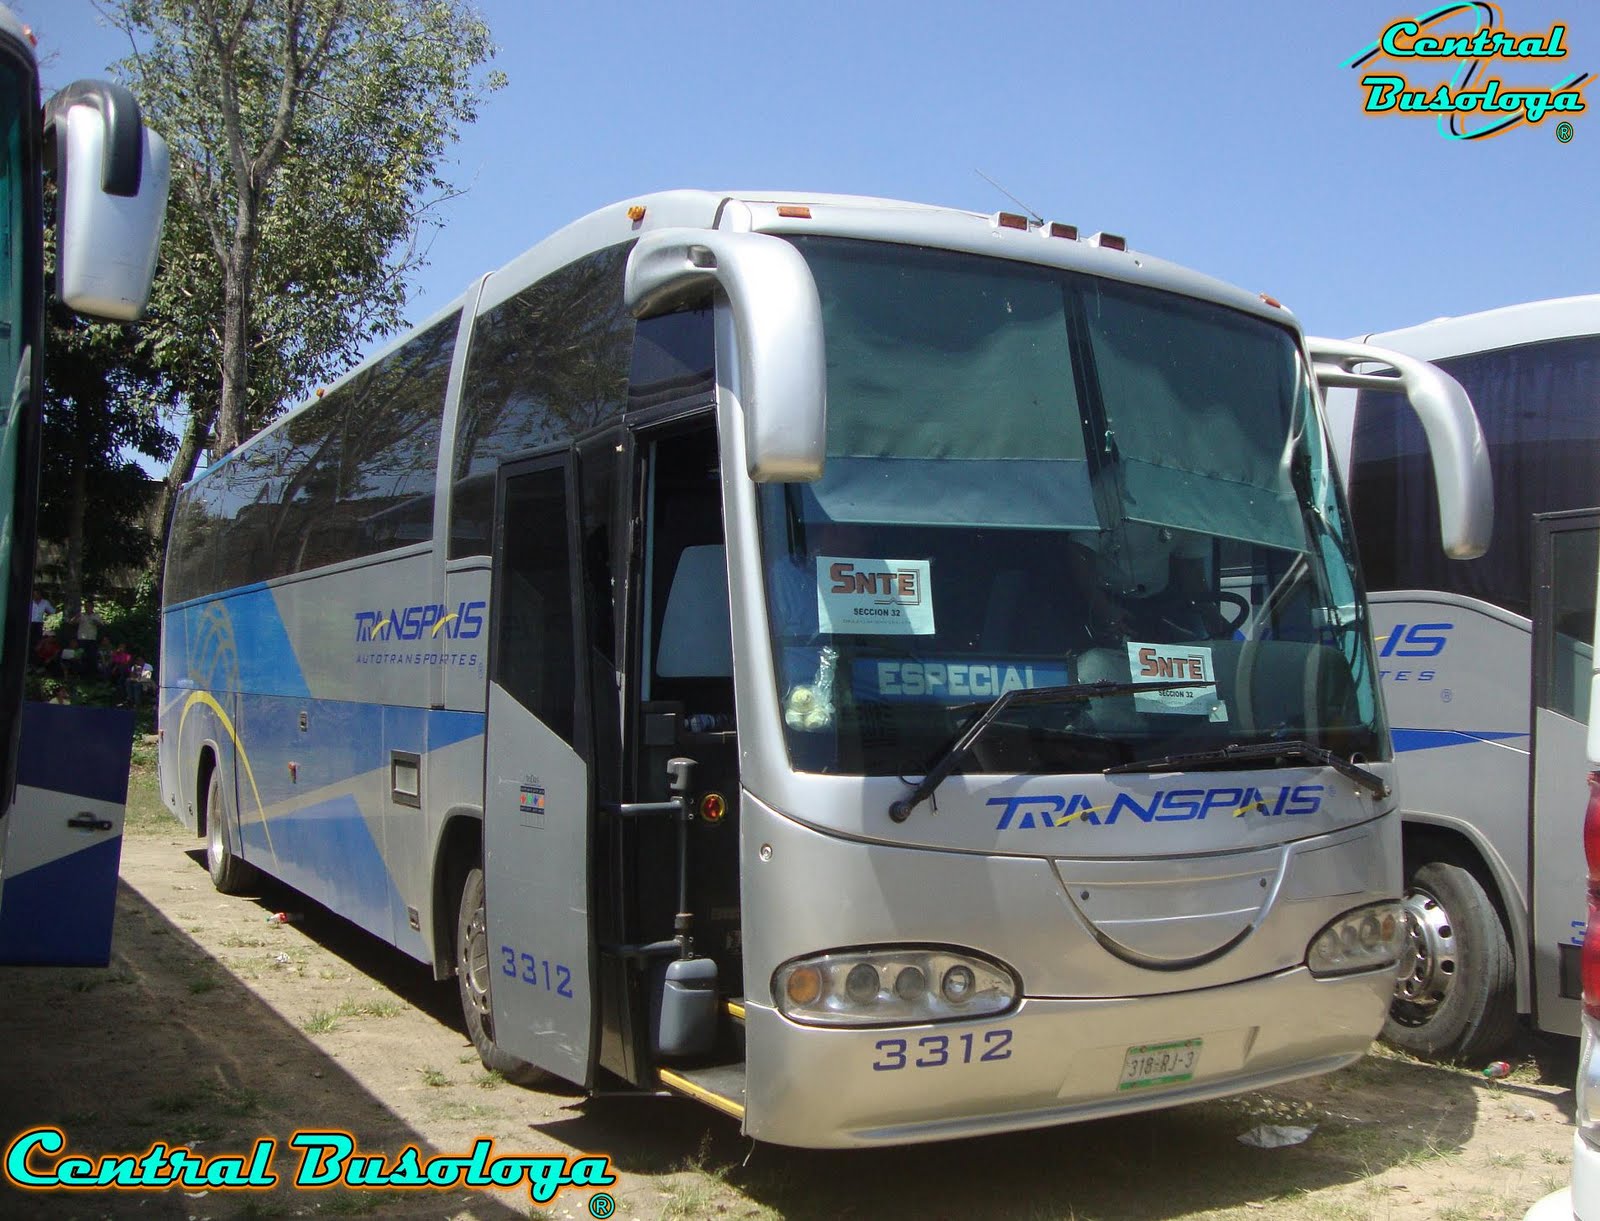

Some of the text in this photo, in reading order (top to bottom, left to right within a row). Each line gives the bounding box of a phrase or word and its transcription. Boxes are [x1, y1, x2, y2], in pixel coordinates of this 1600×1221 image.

[853, 607, 901, 617] SECCION 32
[356, 653, 478, 666] AUTOTRANSPORTES
[502, 945, 573, 999] 3312
[872, 1029, 1014, 1072] 3312
